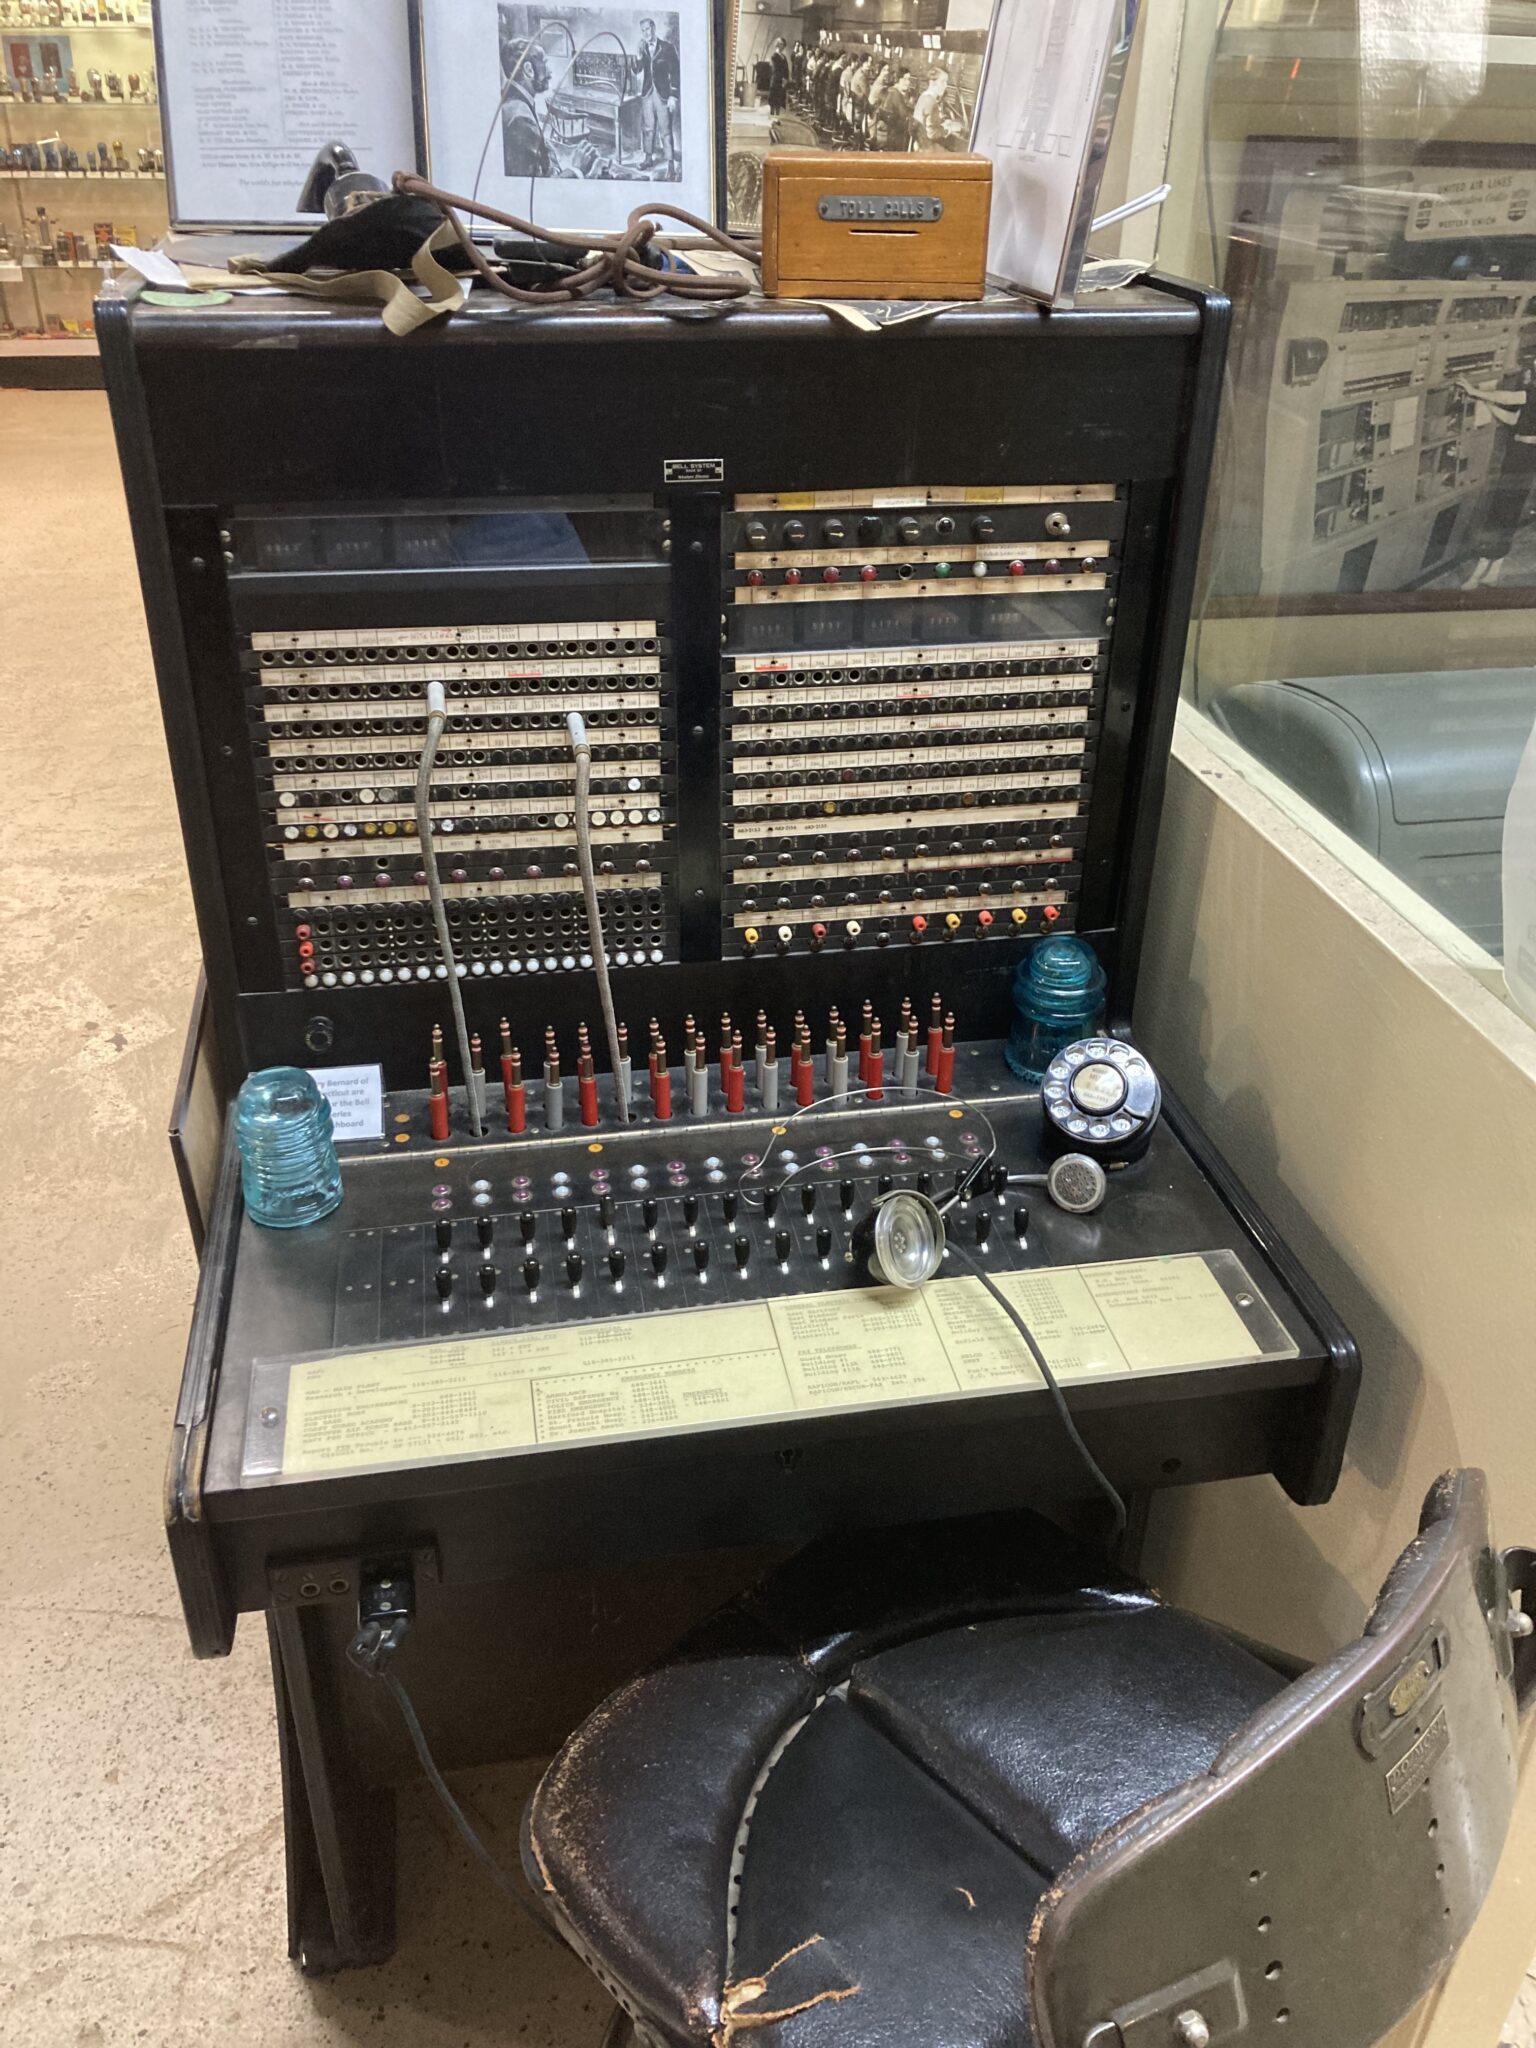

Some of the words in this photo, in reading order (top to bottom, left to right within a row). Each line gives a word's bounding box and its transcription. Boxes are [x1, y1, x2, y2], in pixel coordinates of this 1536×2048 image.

[1438, 182, 1466, 194] UNITED
[1470, 180, 1484, 191] AIR
[1487, 176, 1513, 188] LINES
[840, 199, 876, 218] TOLL
[884, 200, 926, 219] CALLS
[327, 1078, 359, 1087] Bernard
[360, 1077, 369, 1085] of
[340, 1099, 353, 1107] the
[355, 1098, 370, 1106] Bell
[332, 1110, 352, 1118] eries
[335, 1119, 364, 1128] hboard
